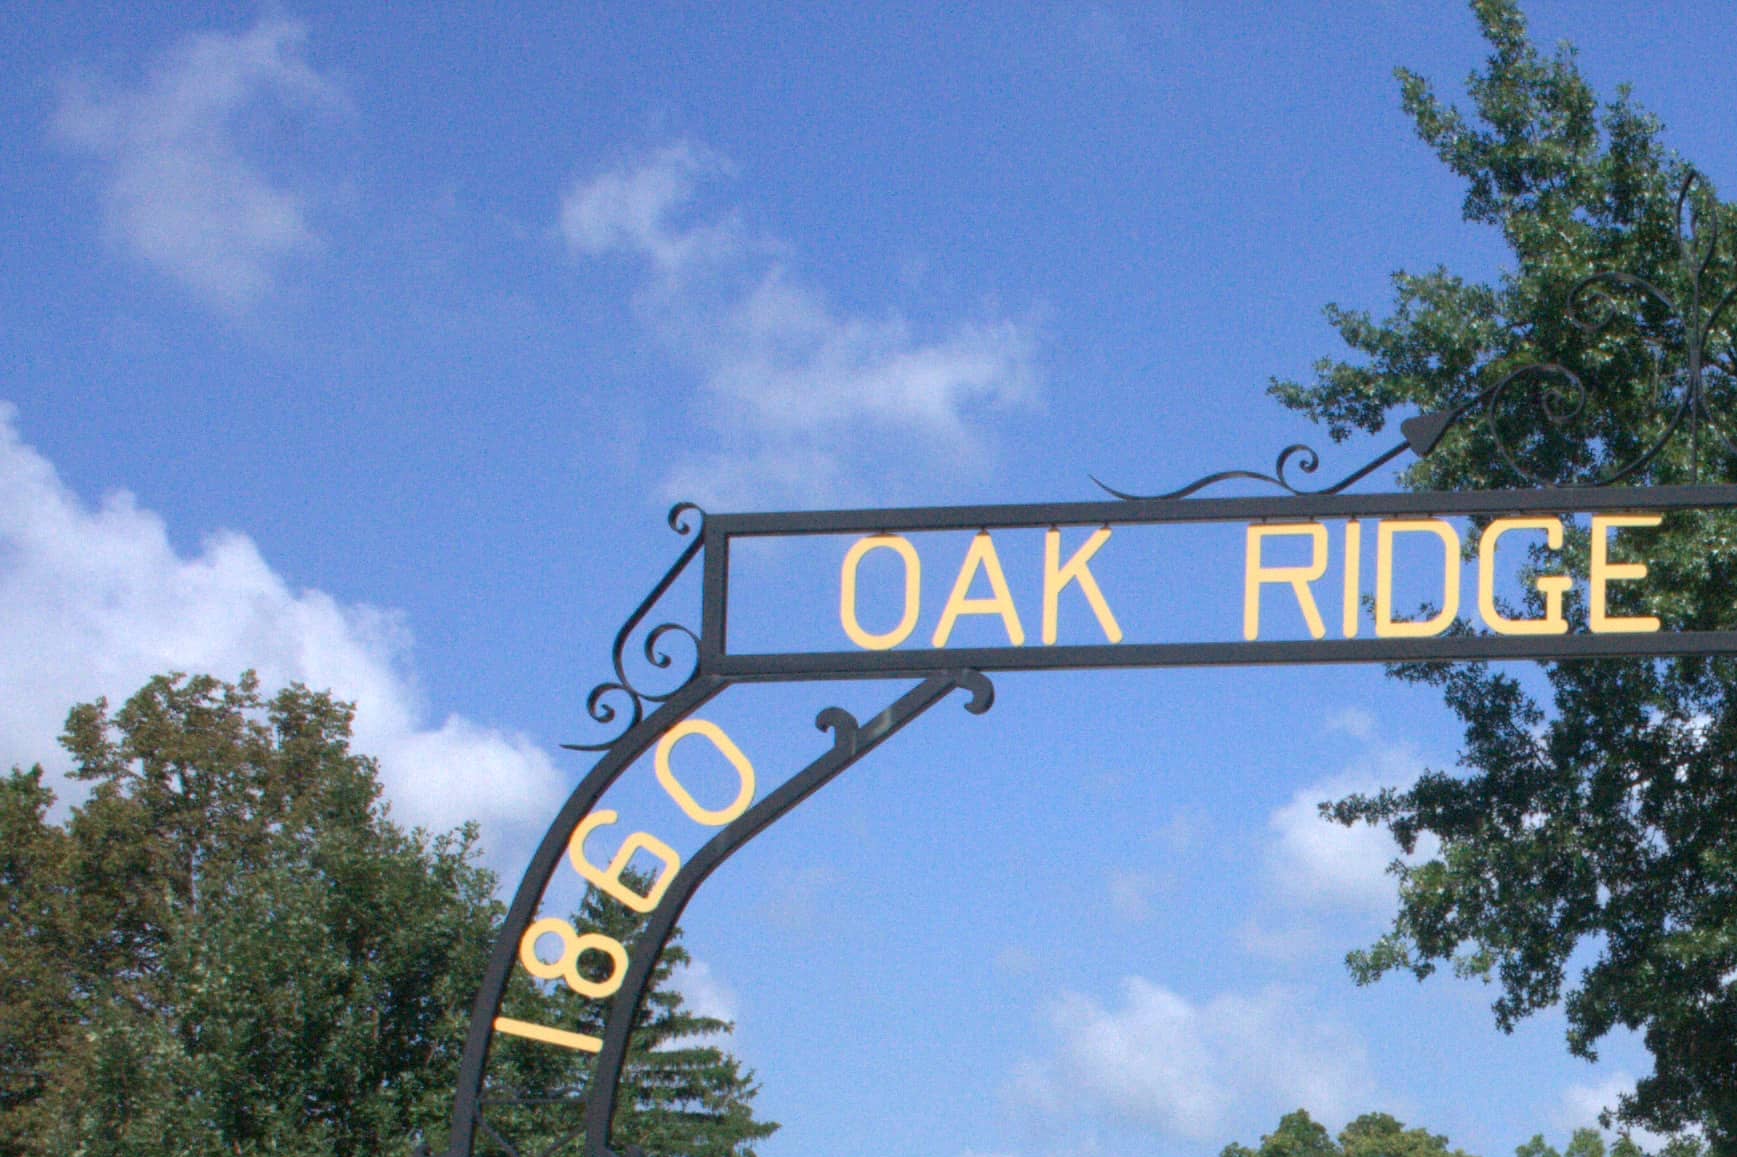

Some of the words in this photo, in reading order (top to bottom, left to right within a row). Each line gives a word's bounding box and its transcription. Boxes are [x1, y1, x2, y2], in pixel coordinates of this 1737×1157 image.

[840, 527, 1123, 650] OAK
[1243, 513, 1662, 641] RIDGE
[493, 720, 756, 1053] 1860
